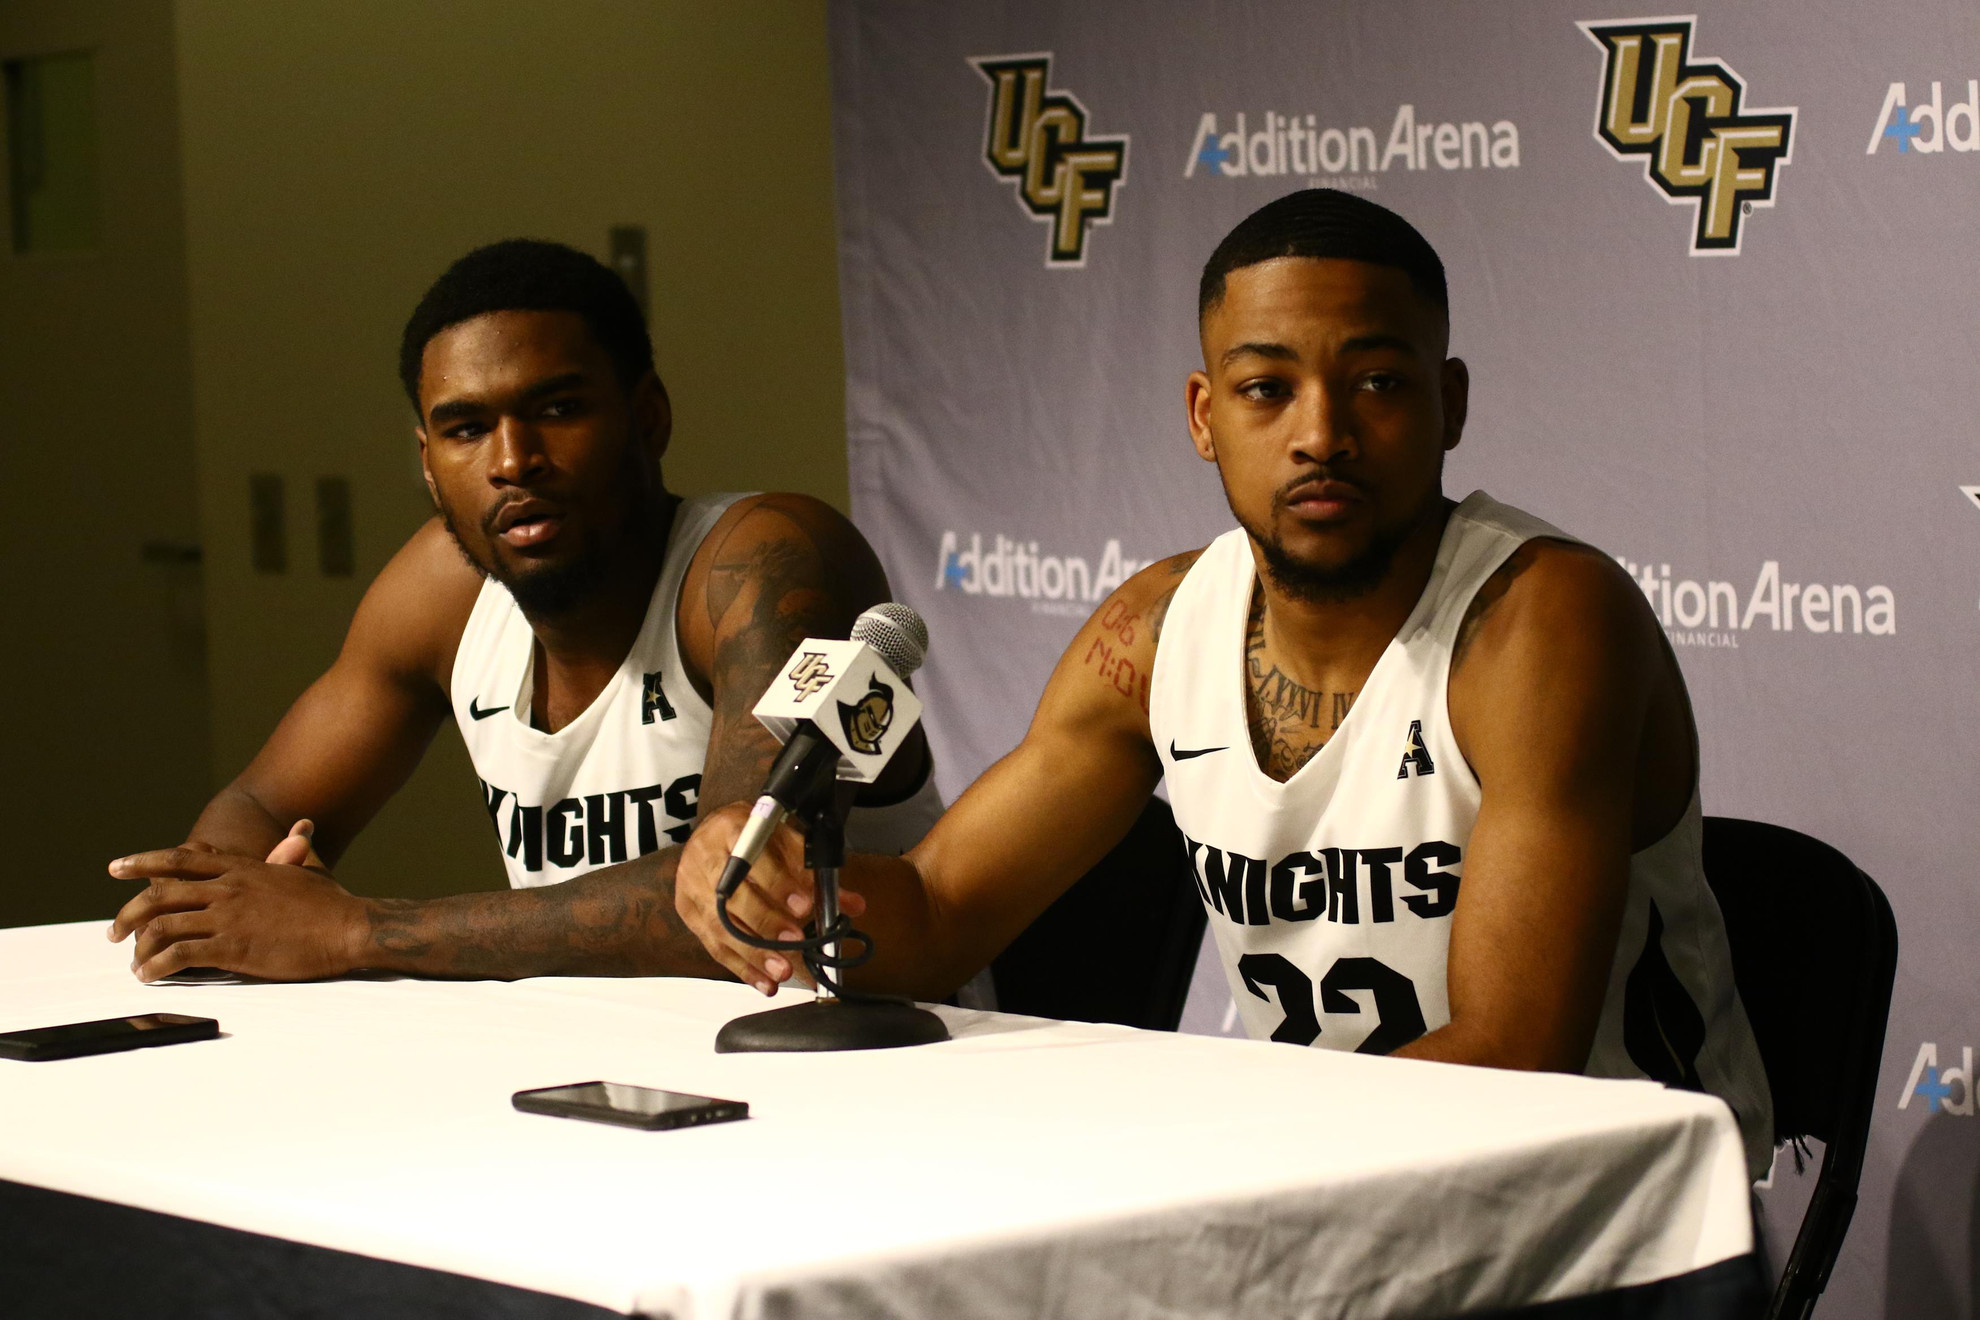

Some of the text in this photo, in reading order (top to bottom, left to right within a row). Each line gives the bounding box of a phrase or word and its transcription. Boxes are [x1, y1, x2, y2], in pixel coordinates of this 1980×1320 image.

[970, 53, 1128, 266] UCF
[1184, 104, 1520, 178] Addition Arena
[1578, 16, 1797, 254] UCF
[935, 530, 1155, 601] Addition Ar
[1616, 556, 1897, 635] tion Arena
[789, 652, 835, 702] UCF
[1184, 834, 1462, 926] KNIGHTS
[1897, 1042, 1980, 1116] Ad
